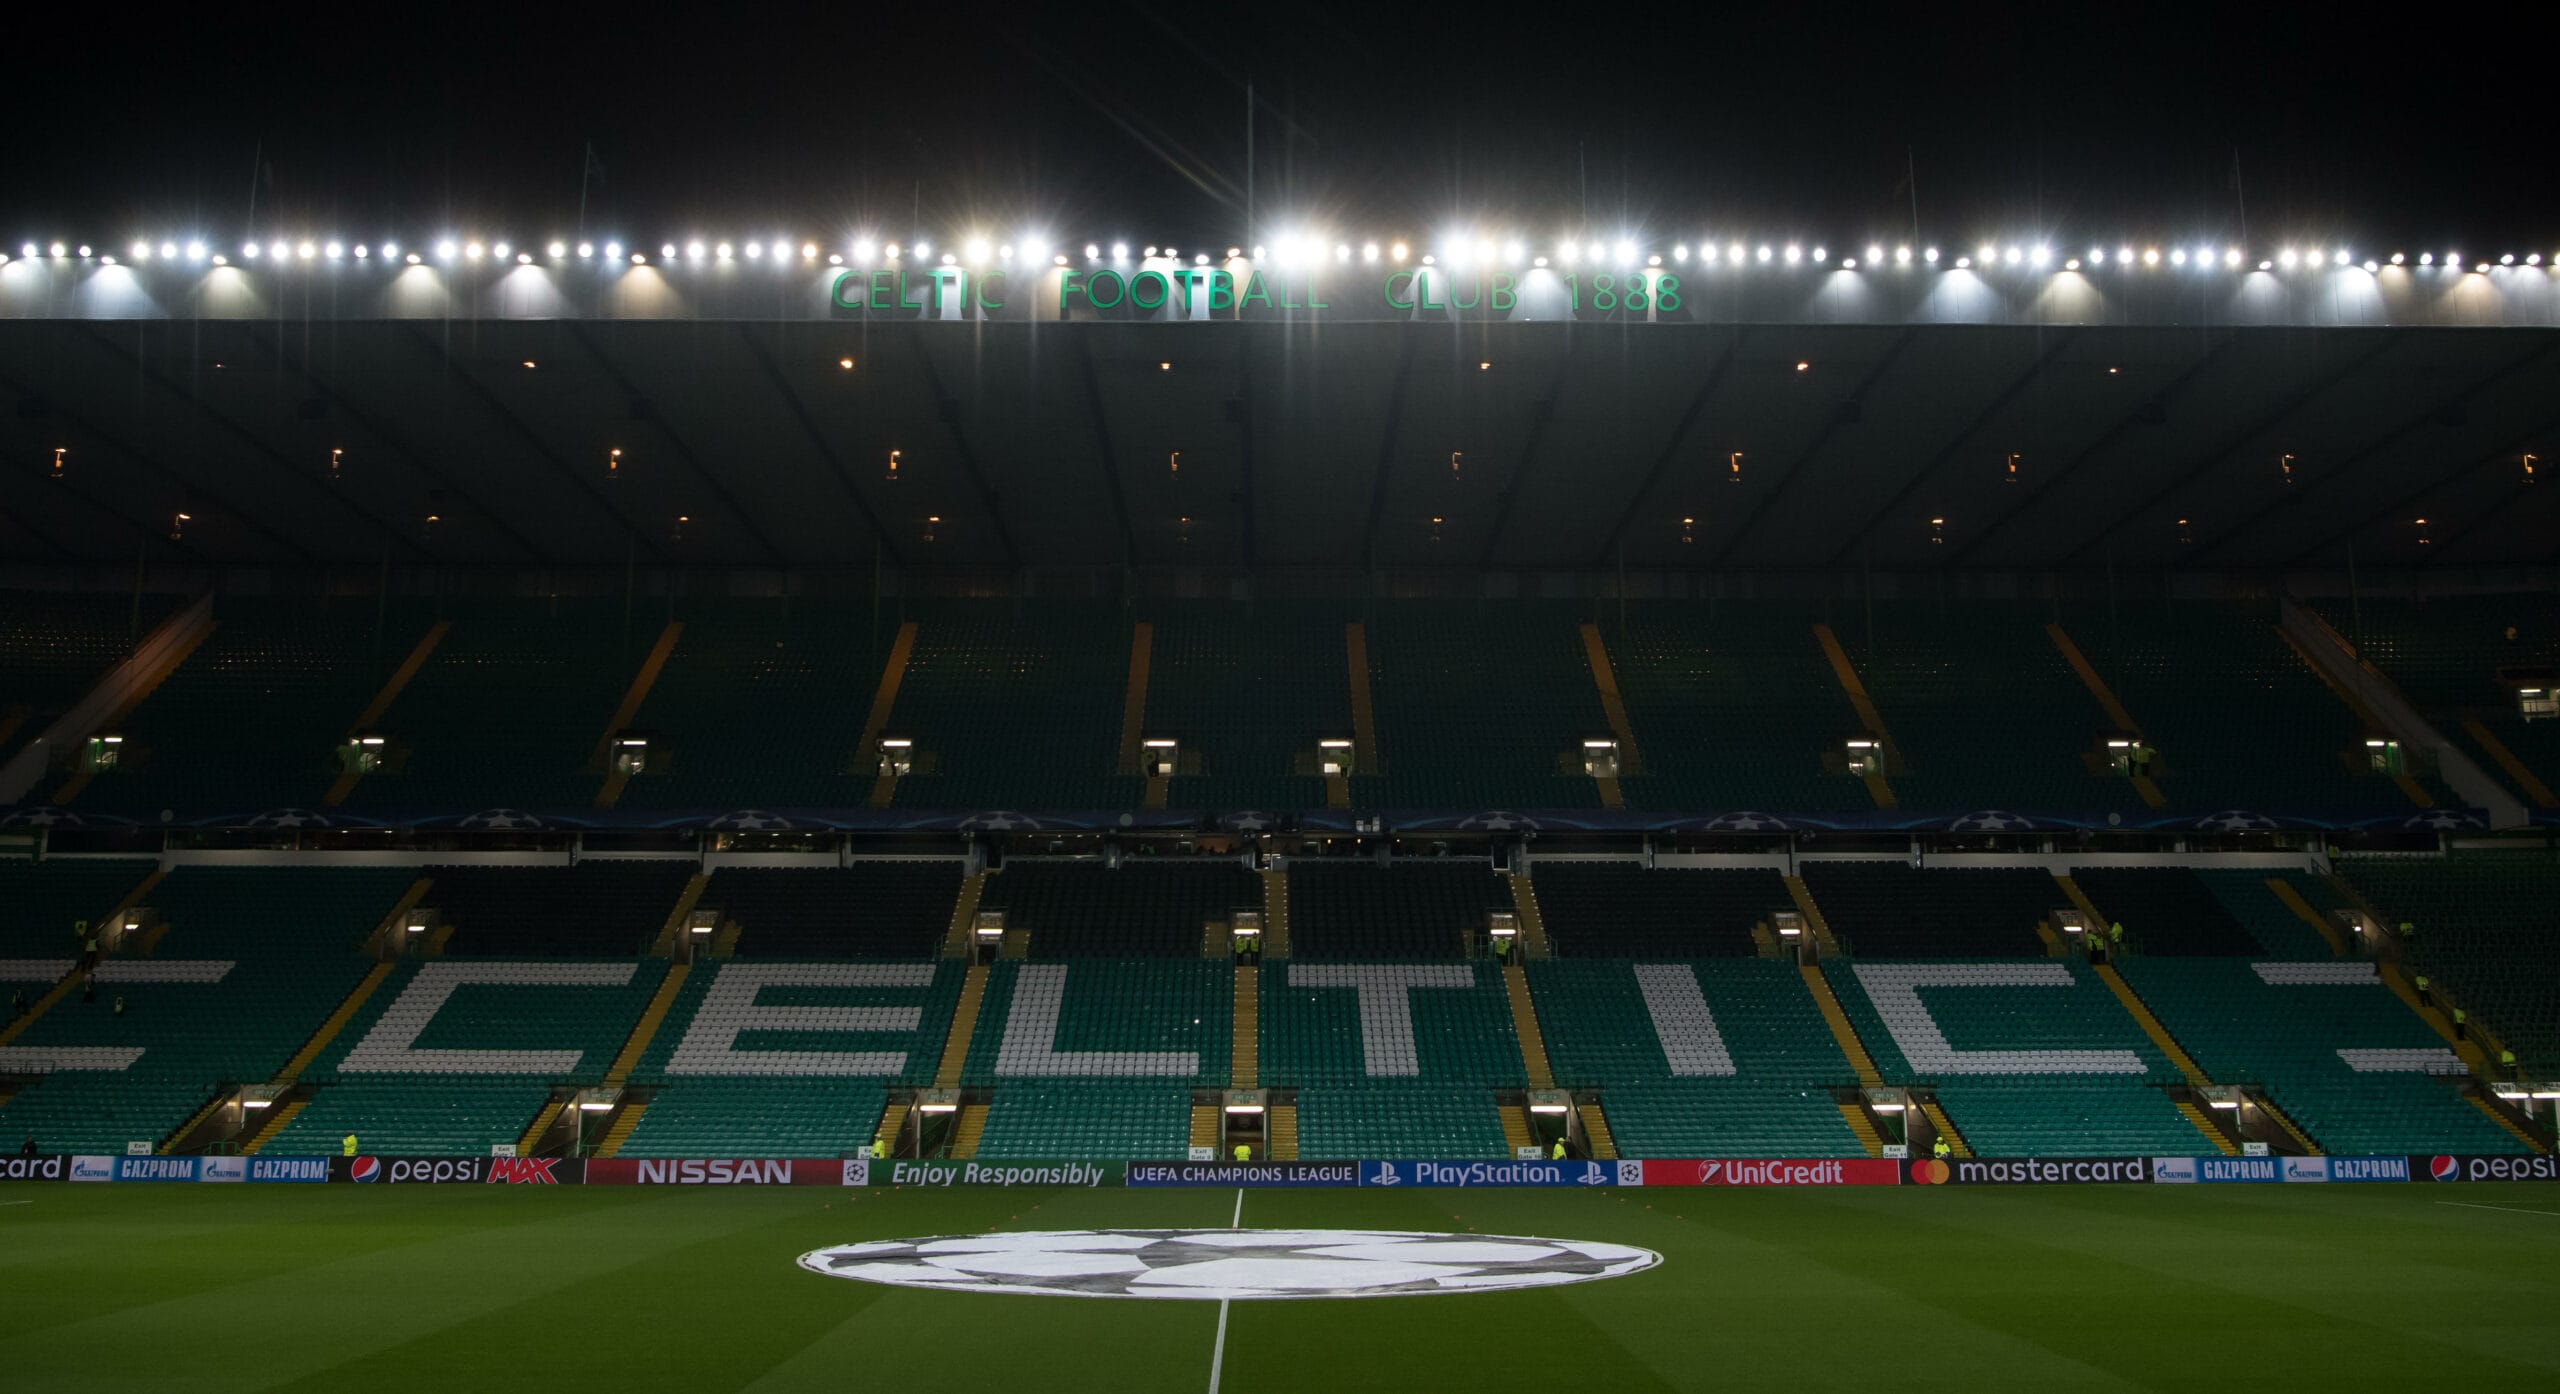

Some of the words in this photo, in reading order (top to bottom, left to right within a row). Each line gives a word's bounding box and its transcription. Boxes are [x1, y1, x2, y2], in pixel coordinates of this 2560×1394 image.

[832, 270, 1006, 310] CELTIC
[1060, 270, 1329, 311] FOOTBALL
[1384, 271, 1518, 311] CLUB
[1563, 273, 1681, 312] 1888
[120, 1160, 193, 1178] GAZPROM
[253, 1160, 326, 1179] GAZPROM
[389, 1157, 480, 1184] pepsi
[486, 1157, 562, 1185] MAX
[637, 1159, 792, 1184] NISSAN
[892, 1162, 957, 1187] Enjoy
[964, 1162, 1105, 1187] Responsibly
[1133, 1167, 1178, 1182] UEFA
[1182, 1167, 1282, 1182] CHAMPIONS
[1287, 1167, 1353, 1181] LEAGUE
[1415, 1162, 1560, 1187] PlayStation
[1726, 1160, 1843, 1184] UniCredit
[1959, 1157, 2144, 1182] mastercard
[2203, 1160, 2275, 1179] GAZPROM
[2334, 1160, 2405, 1179] GAZPROM
[2468, 1155, 2557, 1182] pepsi
